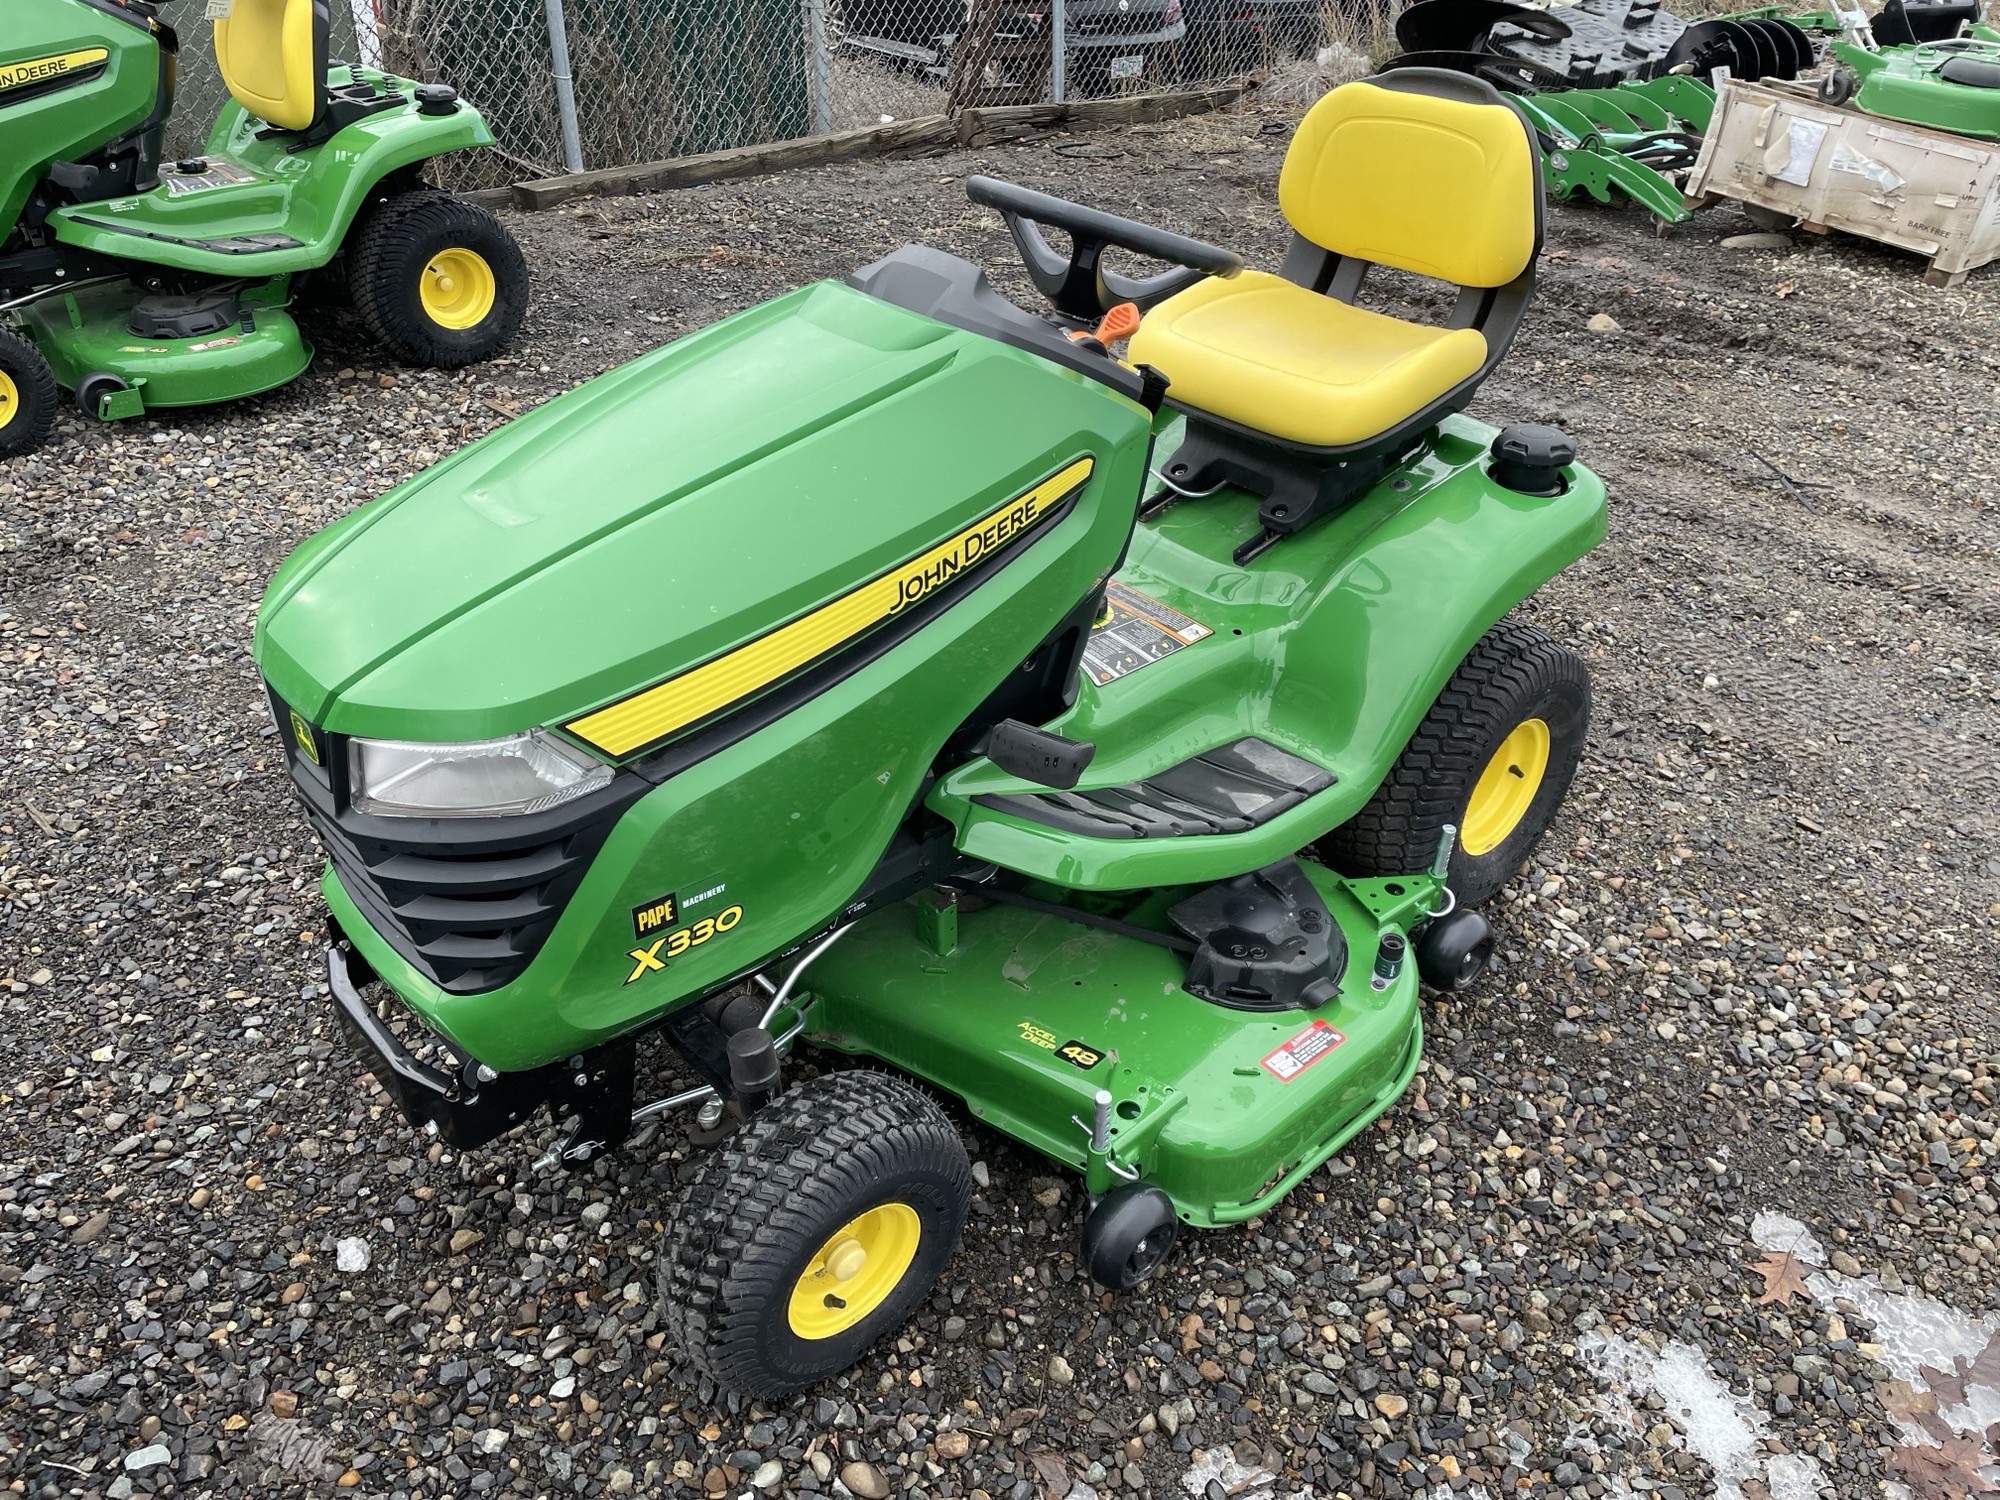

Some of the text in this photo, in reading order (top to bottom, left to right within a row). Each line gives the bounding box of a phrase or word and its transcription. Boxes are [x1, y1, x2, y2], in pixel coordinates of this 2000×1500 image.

[16, 59, 68, 82] DEERE
[1907, 219, 1951, 238] BARK FREE
[889, 495, 1038, 612] JOHN DEERE
[682, 883, 726, 909] MACHINERY
[622, 904, 744, 987] X330
[1017, 1022, 1056, 1044] ACCEL
[1020, 1031, 1056, 1050] DEEP
[1062, 1046, 1099, 1066] 48
